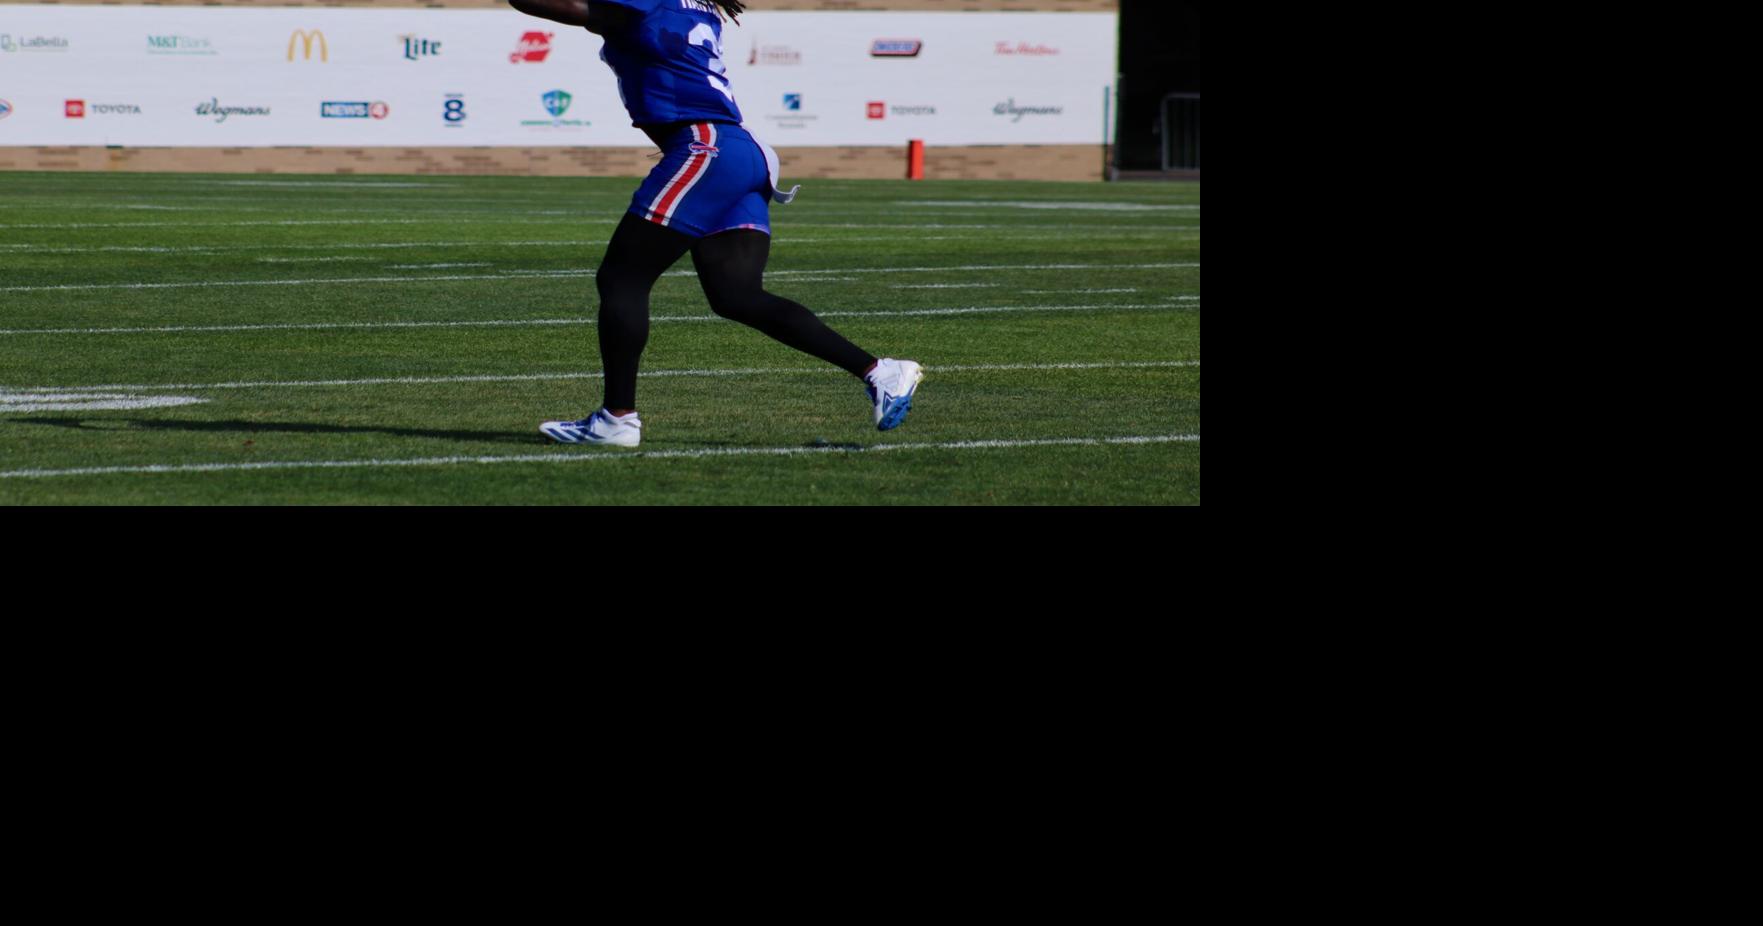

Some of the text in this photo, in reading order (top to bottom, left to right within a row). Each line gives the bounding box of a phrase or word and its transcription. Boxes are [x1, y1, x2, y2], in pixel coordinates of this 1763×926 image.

[20, 35, 69, 48] LaBella
[147, 35, 211, 48] M&T Bank
[401, 34, 442, 60] Lite
[92, 104, 142, 115] TOYOTA
[195, 97, 271, 123] Wegmans
[323, 102, 385, 118] NEWS 4
[443, 99, 466, 121] 8
[891, 105, 936, 116] TOYOTA
[993, 98, 1063, 122] Wegmans
